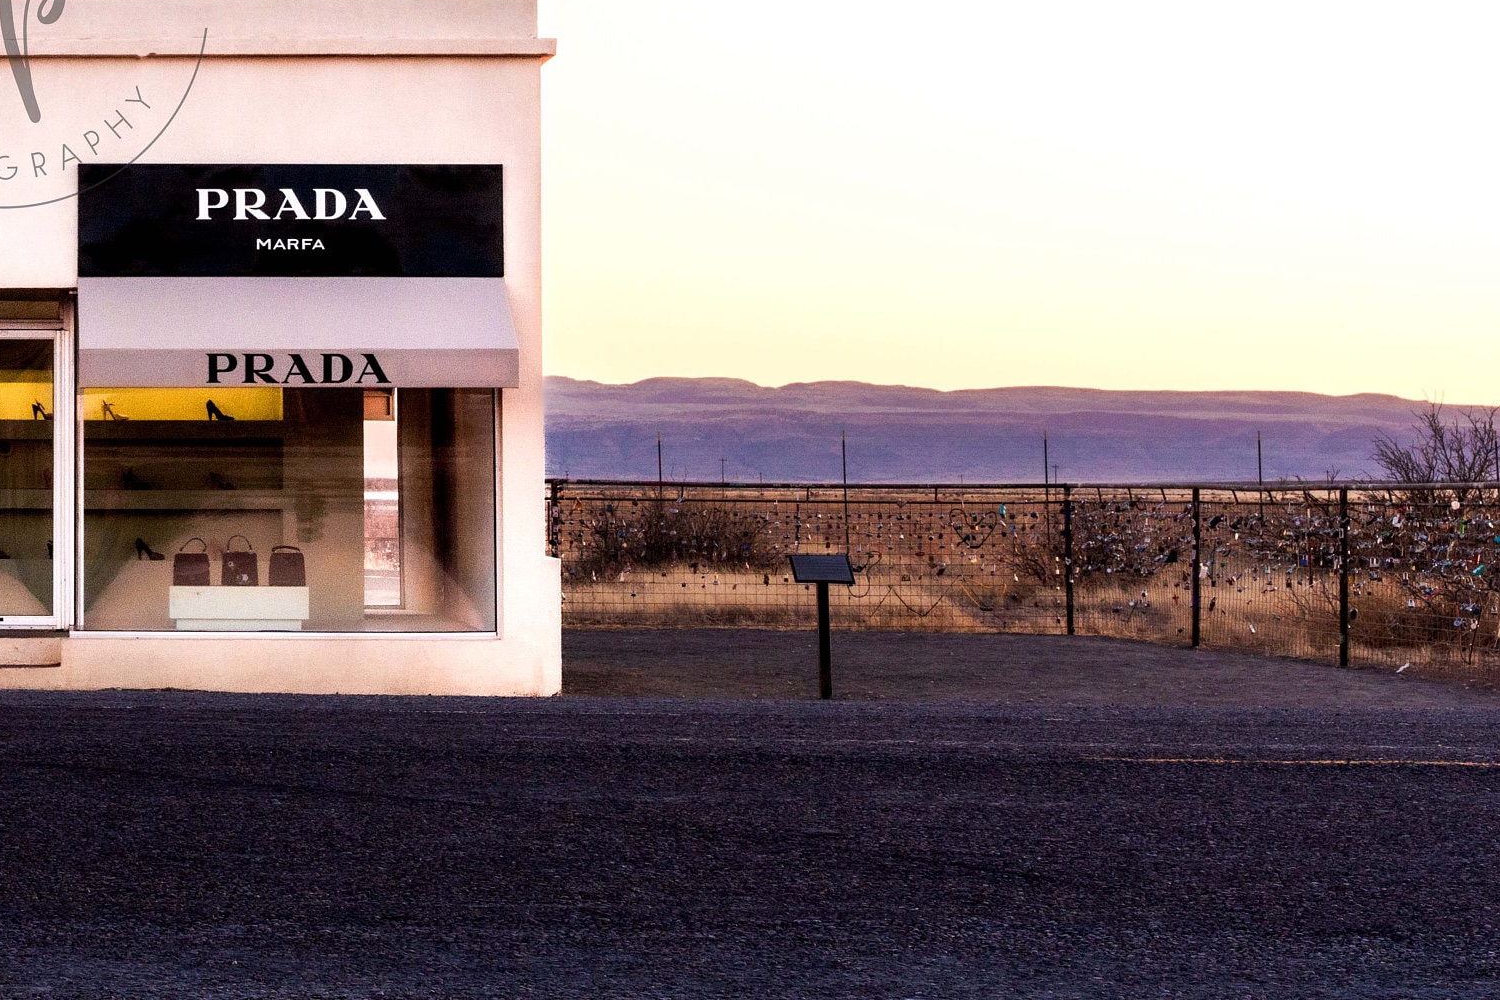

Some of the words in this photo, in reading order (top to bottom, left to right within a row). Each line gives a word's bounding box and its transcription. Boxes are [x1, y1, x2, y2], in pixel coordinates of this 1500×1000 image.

[195, 188, 386, 220] PRADA
[256, 238, 325, 250] MARFA
[206, 353, 391, 384] PRADA
